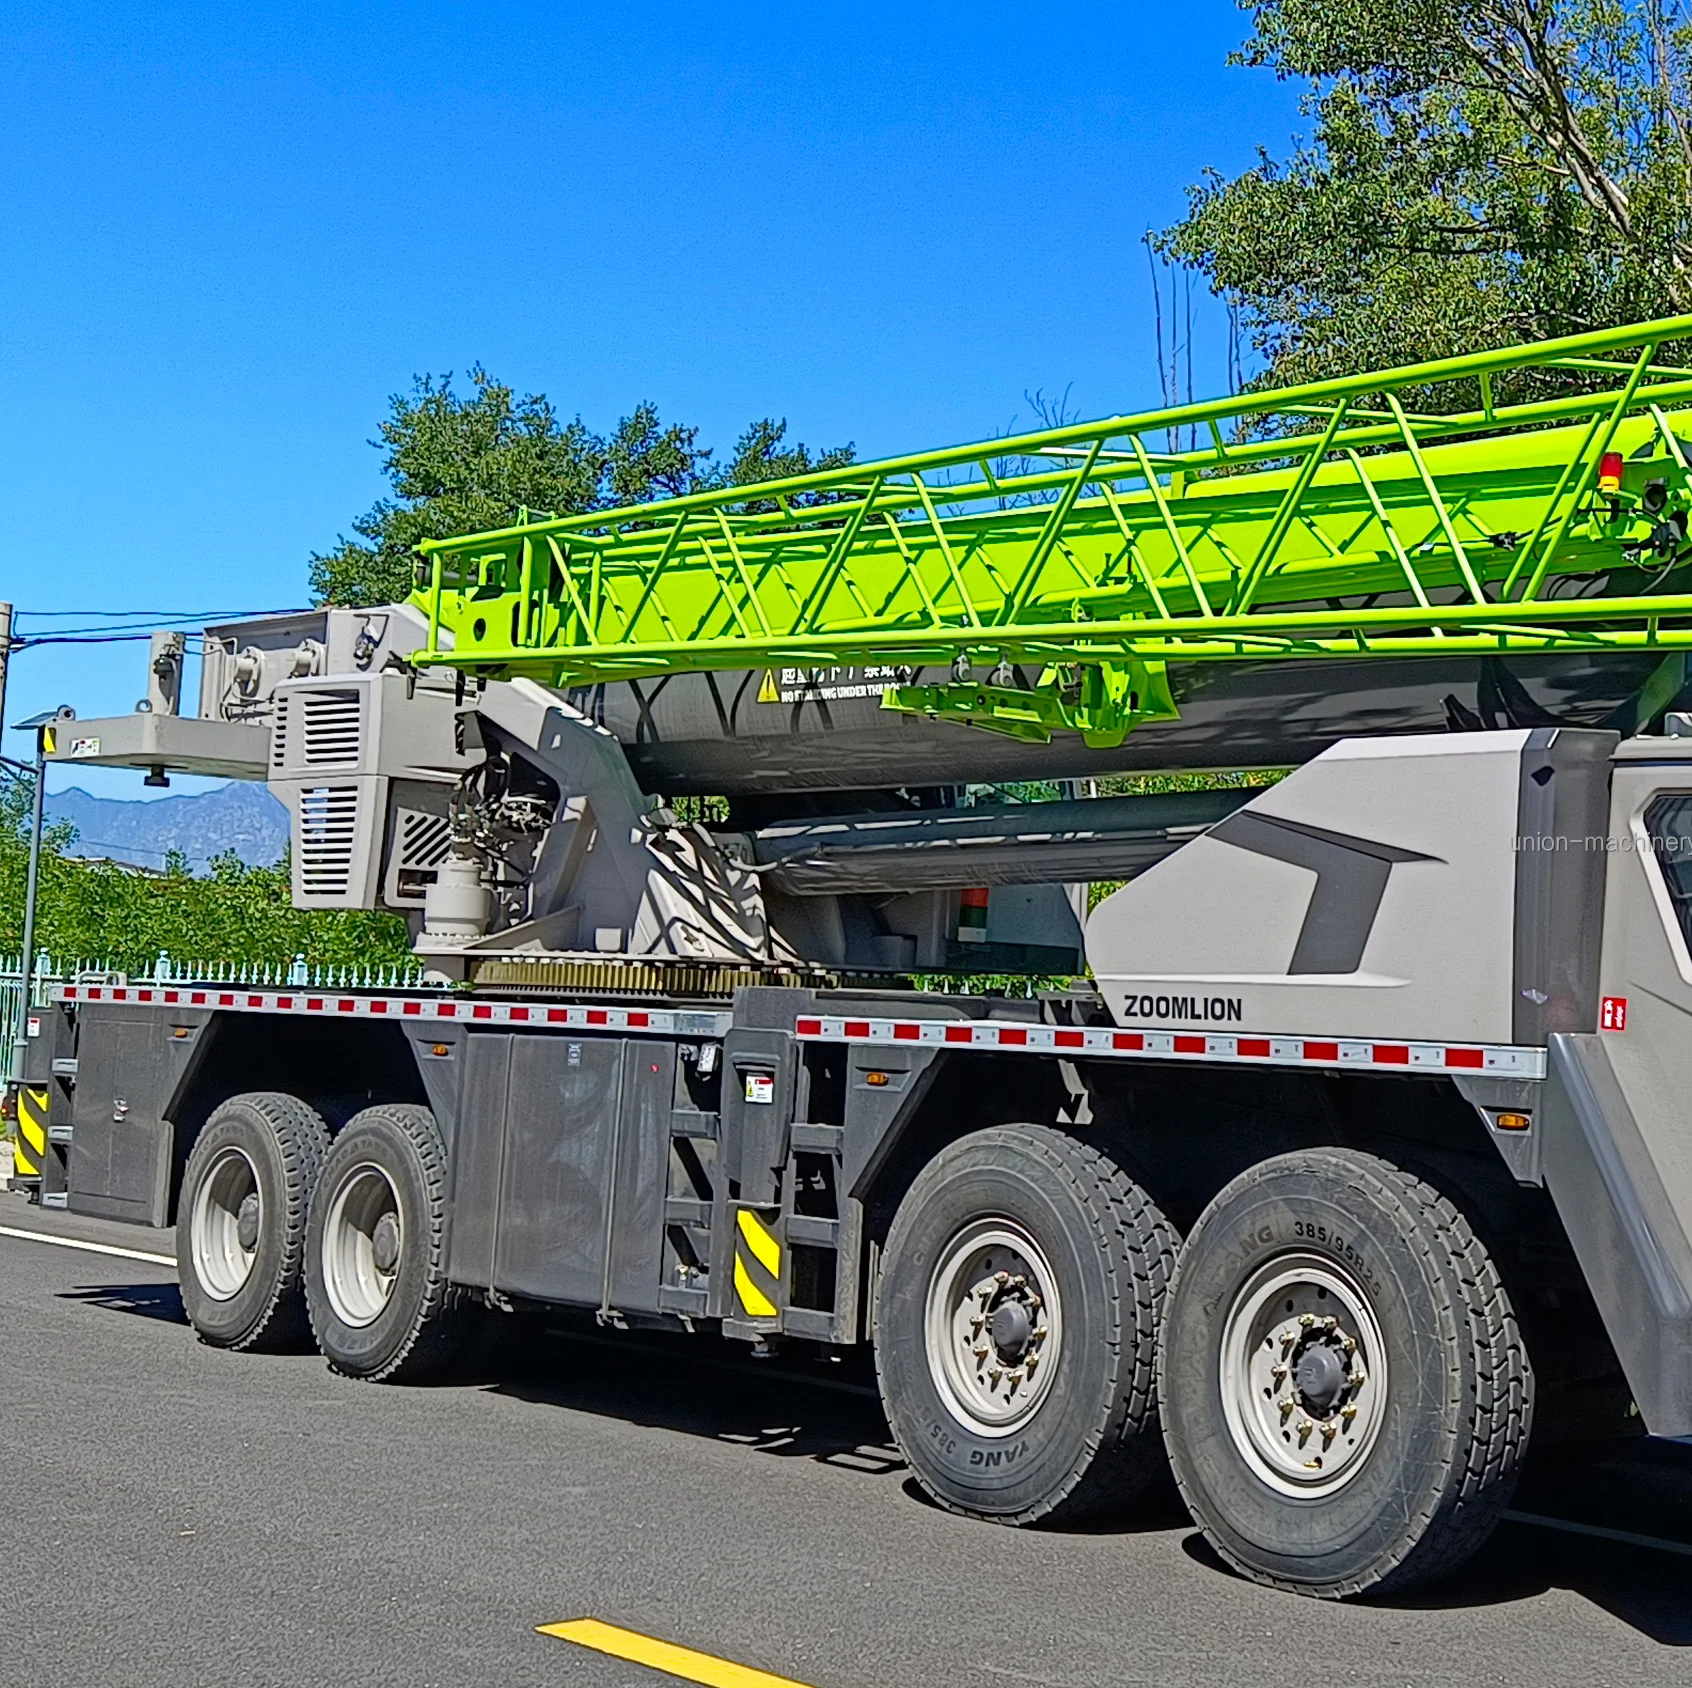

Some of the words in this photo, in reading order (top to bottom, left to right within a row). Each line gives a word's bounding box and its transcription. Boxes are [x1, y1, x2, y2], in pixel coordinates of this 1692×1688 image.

[781, 690, 794, 703] NO
[837, 684, 867, 699] UNDER
[867, 682, 884, 696] THE
[1124, 994, 1242, 1021] ZOOMLION
[1294, 1221, 1382, 1297] 385/95R25
[968, 1440, 1030, 1468] YANG
